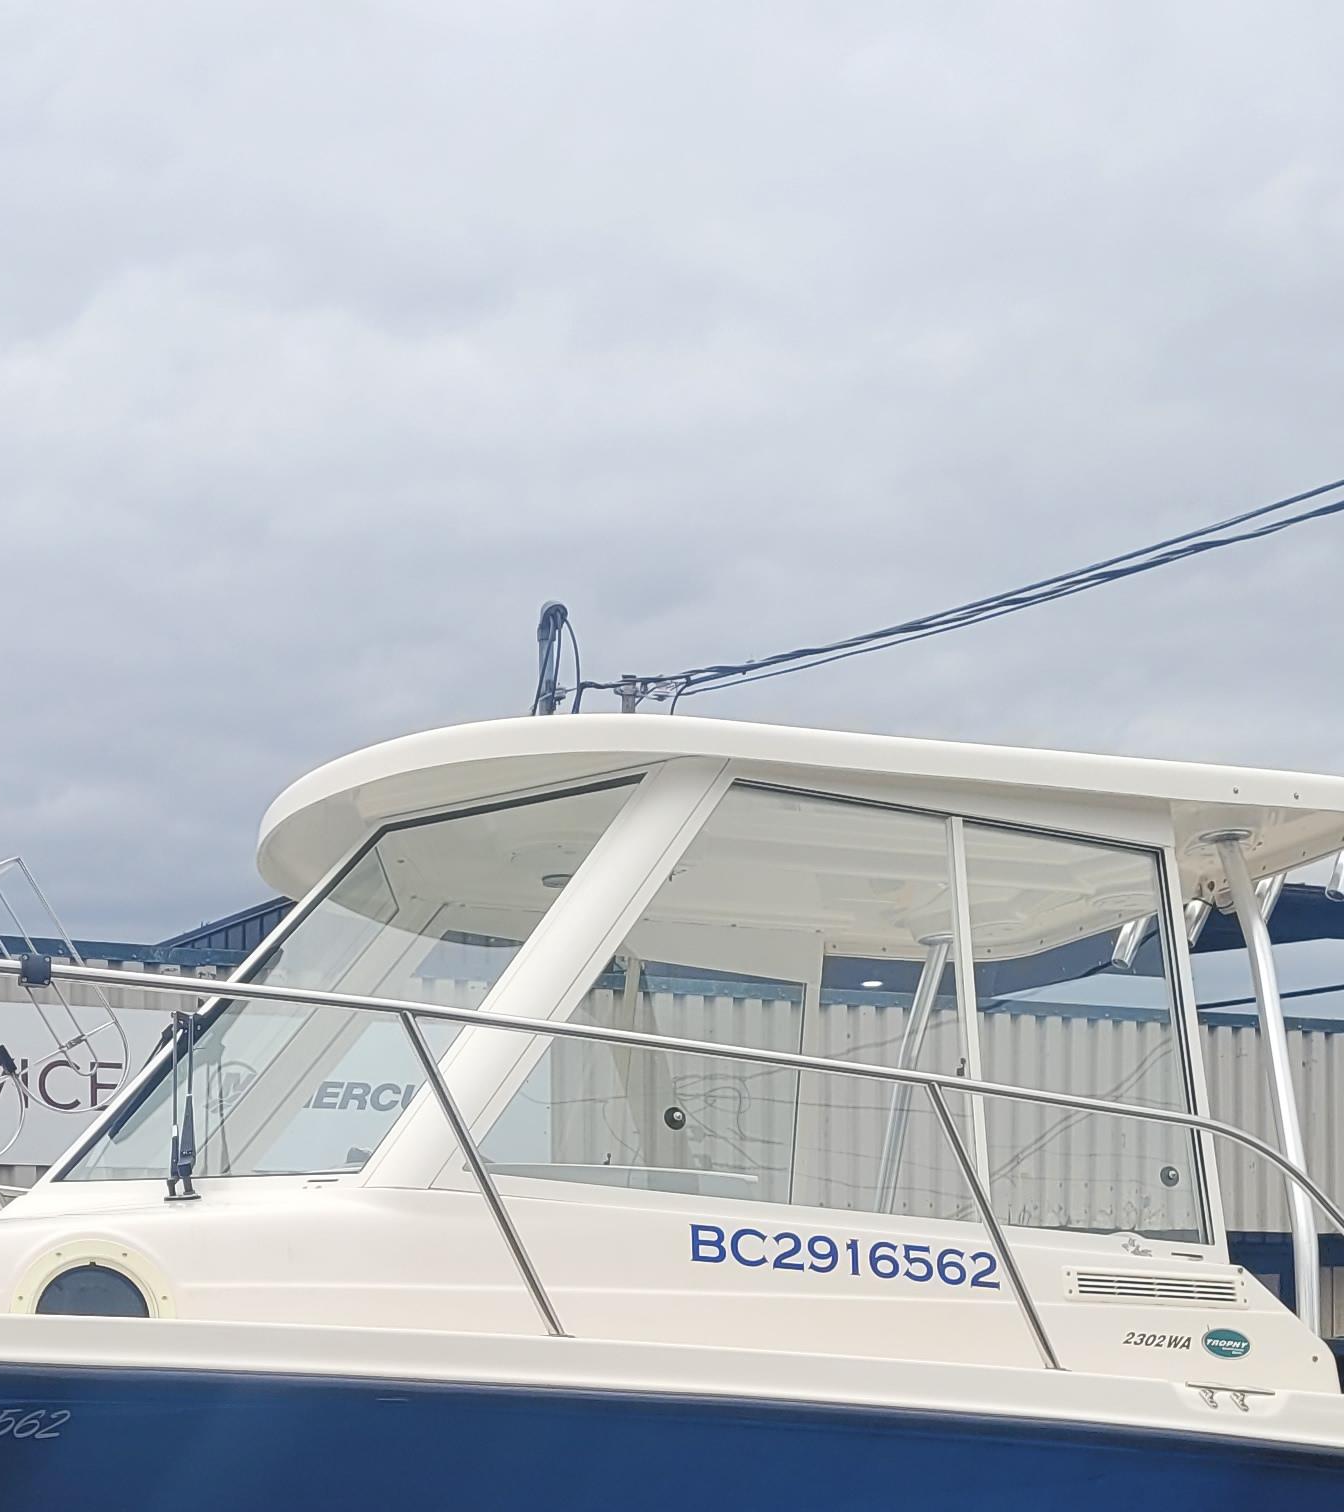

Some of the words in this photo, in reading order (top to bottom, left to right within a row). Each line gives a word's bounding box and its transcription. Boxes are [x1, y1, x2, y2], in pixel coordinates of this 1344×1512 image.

[303, 1080, 417, 1112] ERC
[689, 1223, 1001, 1290] BC2916562
[1122, 1331, 1193, 1350] 2302WA
[1206, 1338, 1249, 1349] TROPHY
